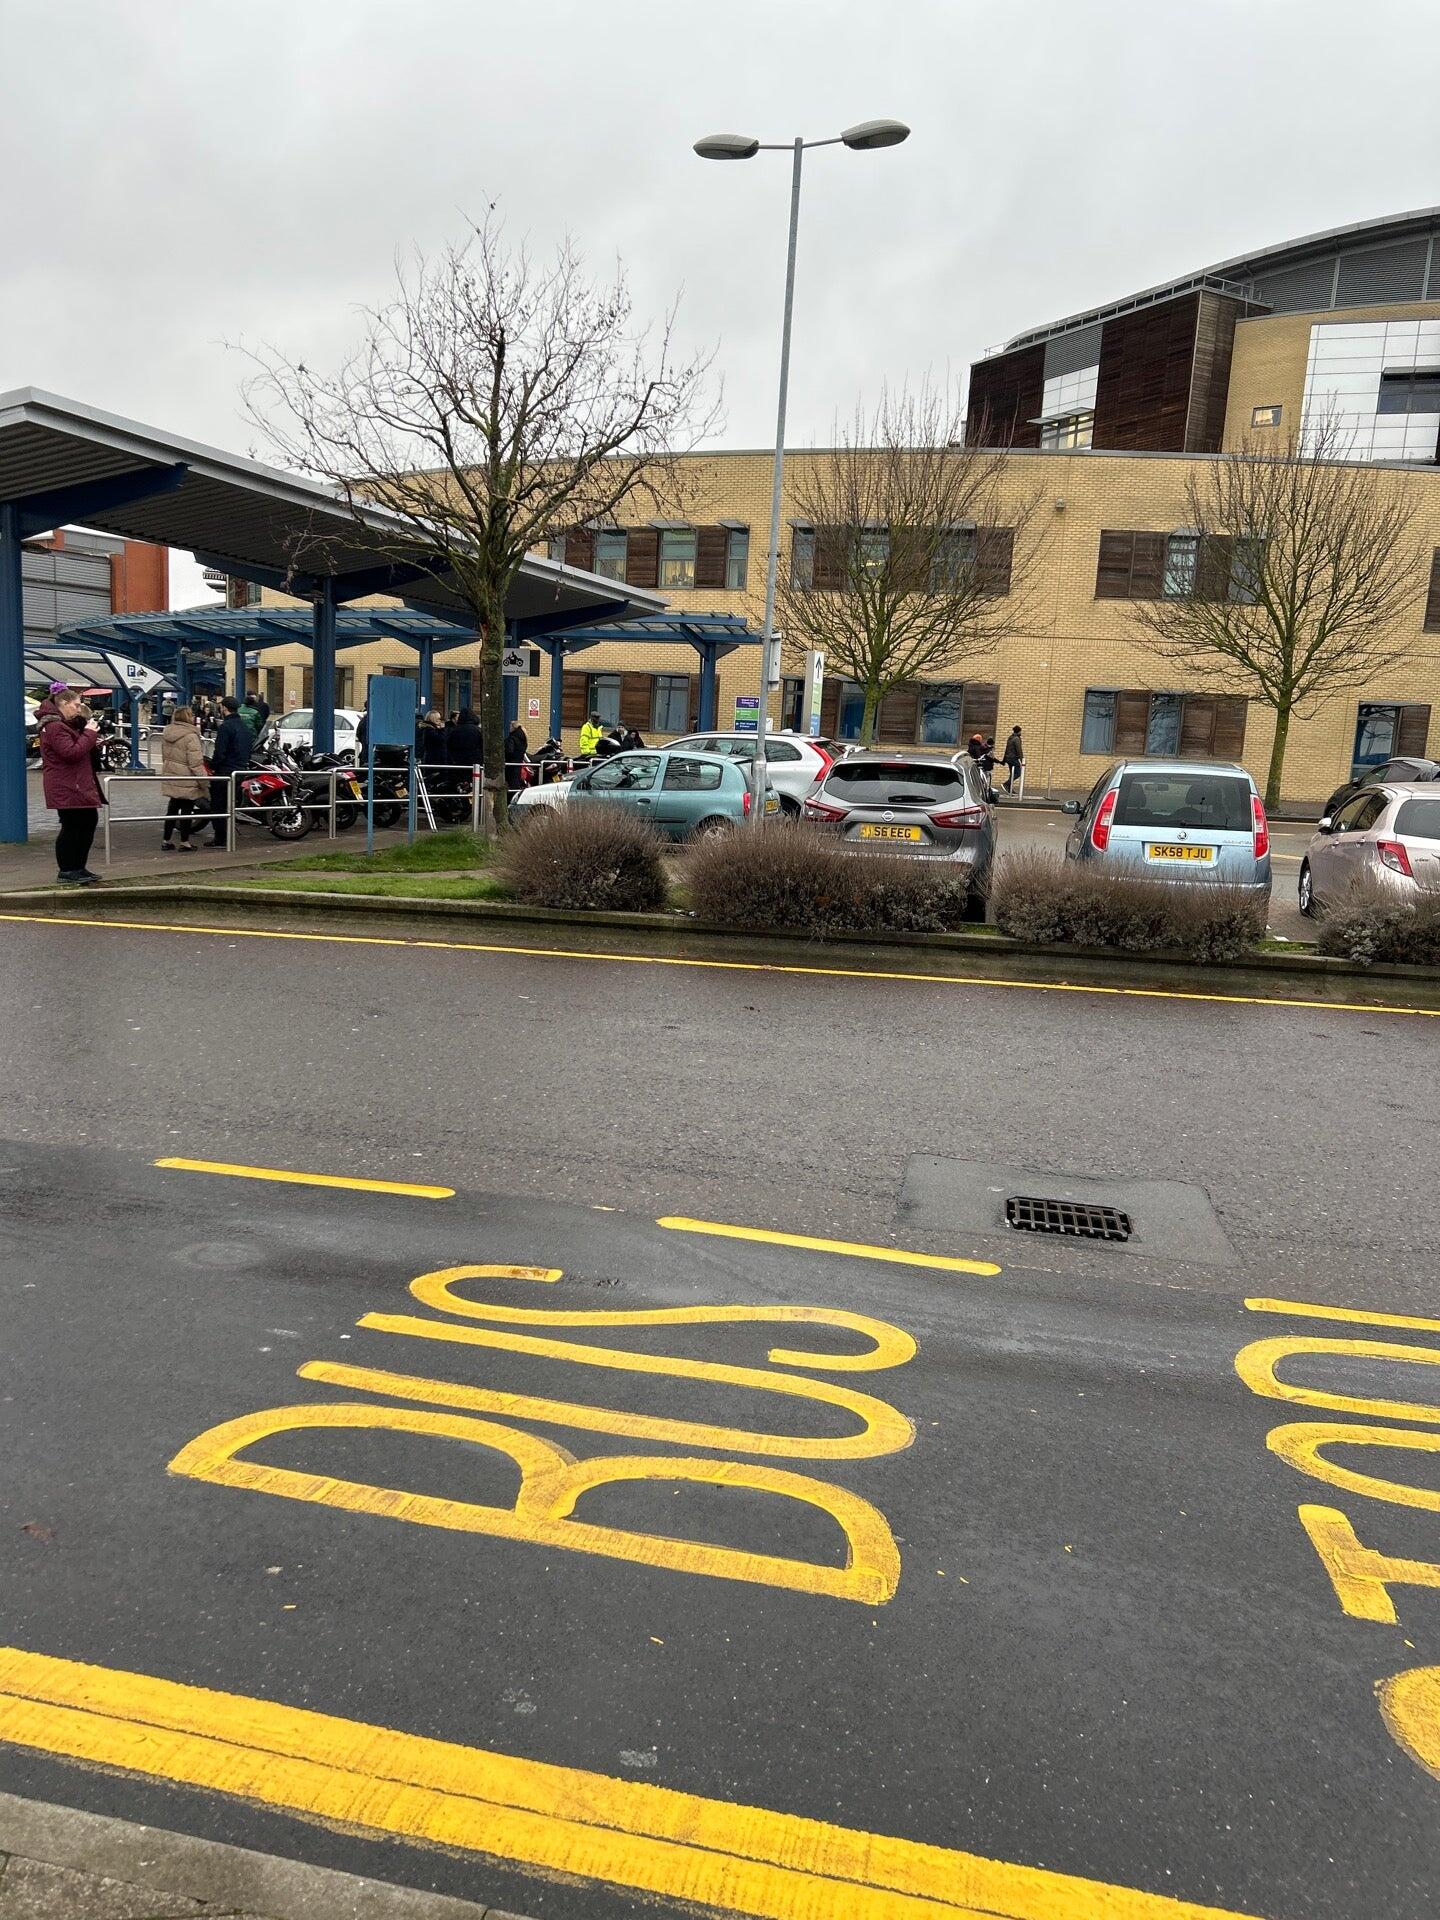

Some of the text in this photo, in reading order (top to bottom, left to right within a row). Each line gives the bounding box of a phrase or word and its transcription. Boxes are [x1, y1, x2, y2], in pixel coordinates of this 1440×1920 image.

[890, 827, 912, 839] EEG
[1154, 846, 1208, 859] SK58 TJU
[166, 1263, 918, 1607] BUS
